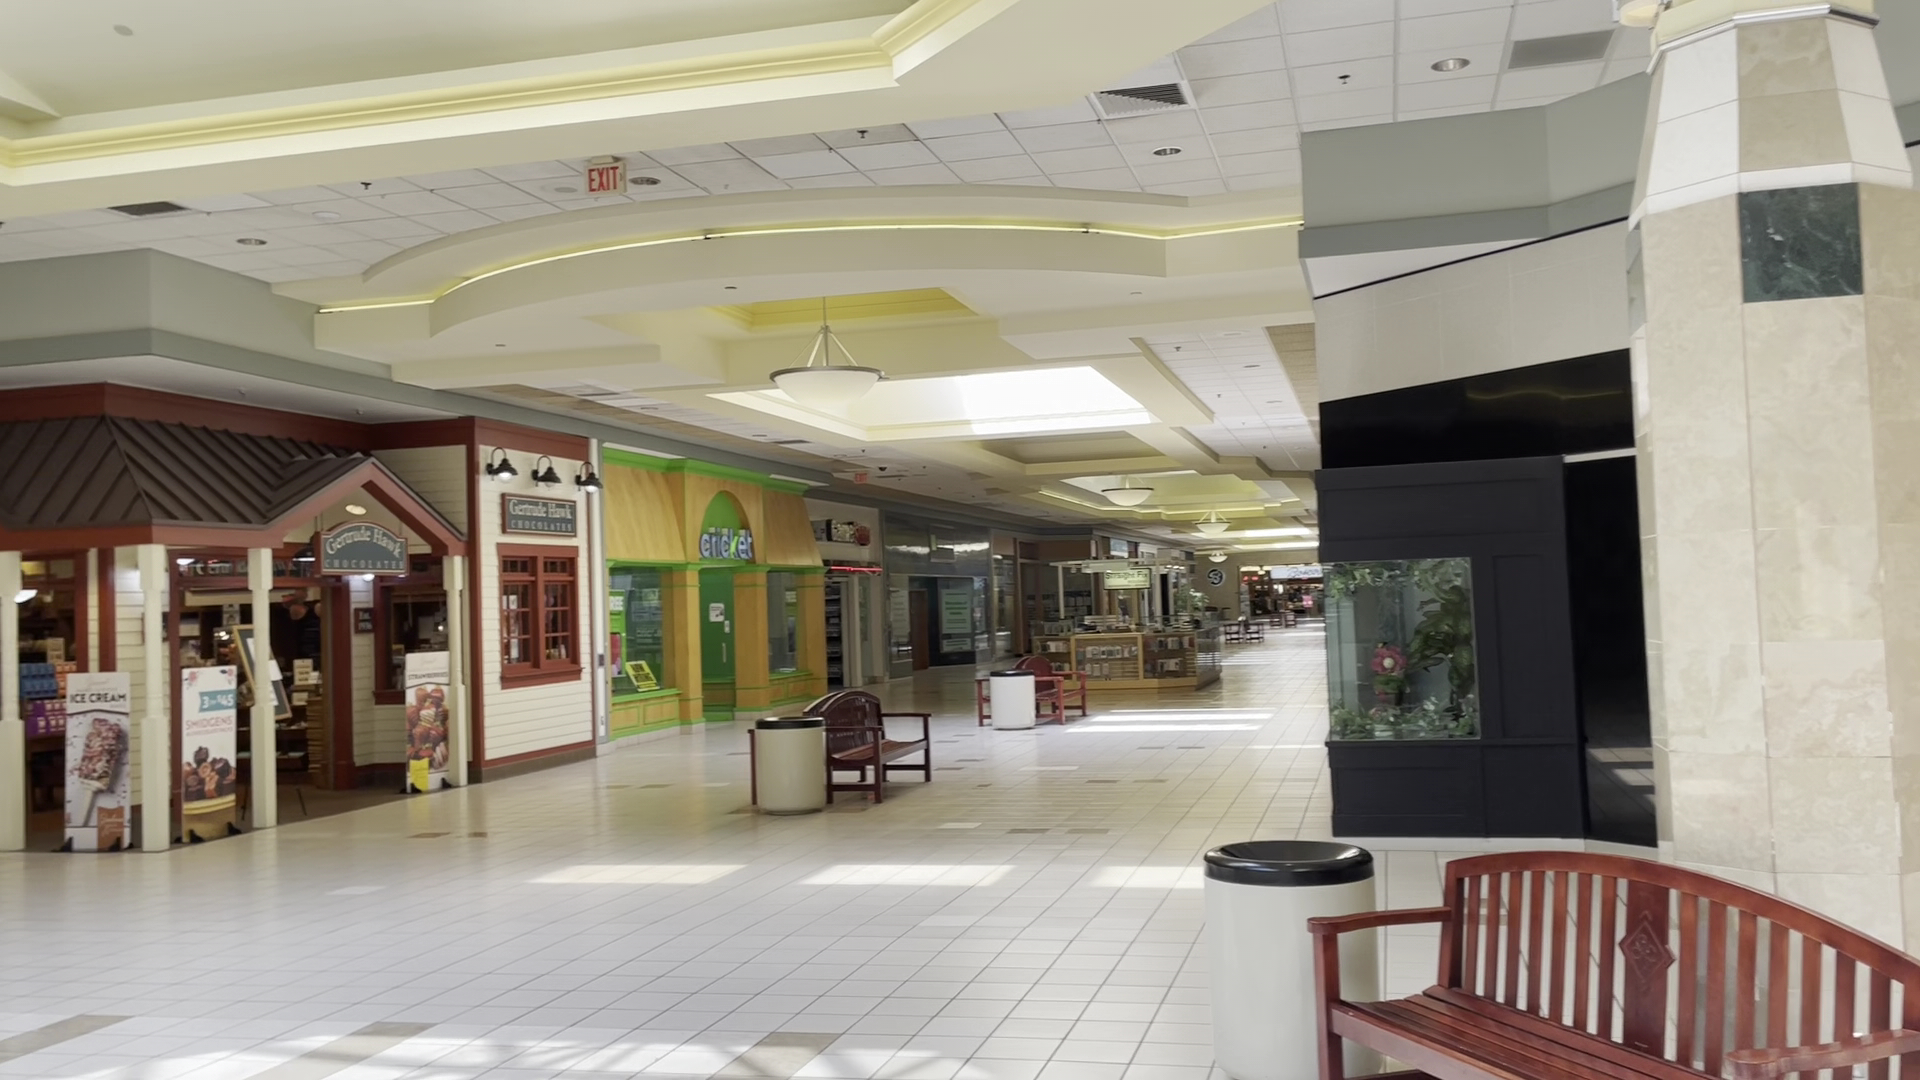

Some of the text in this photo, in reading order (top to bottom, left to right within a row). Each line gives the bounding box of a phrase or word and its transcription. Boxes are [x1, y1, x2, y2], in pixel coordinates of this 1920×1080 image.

[588, 166, 619, 192] EXIT
[509, 500, 572, 519] Gertrude Hawk
[510, 520, 572, 531] CHOCOLATES
[326, 526, 401, 558] Gertrude Hawk
[699, 527, 753, 559] cricket
[325, 559, 404, 569] CHOCOLATES
[1105, 570, 1148, 580] Straight Fix
[70, 692, 127, 703] ICE CREAM
[202, 695, 210, 709] 3
[217, 694, 234, 707] $45
[185, 716, 233, 730] SMIDGENS
